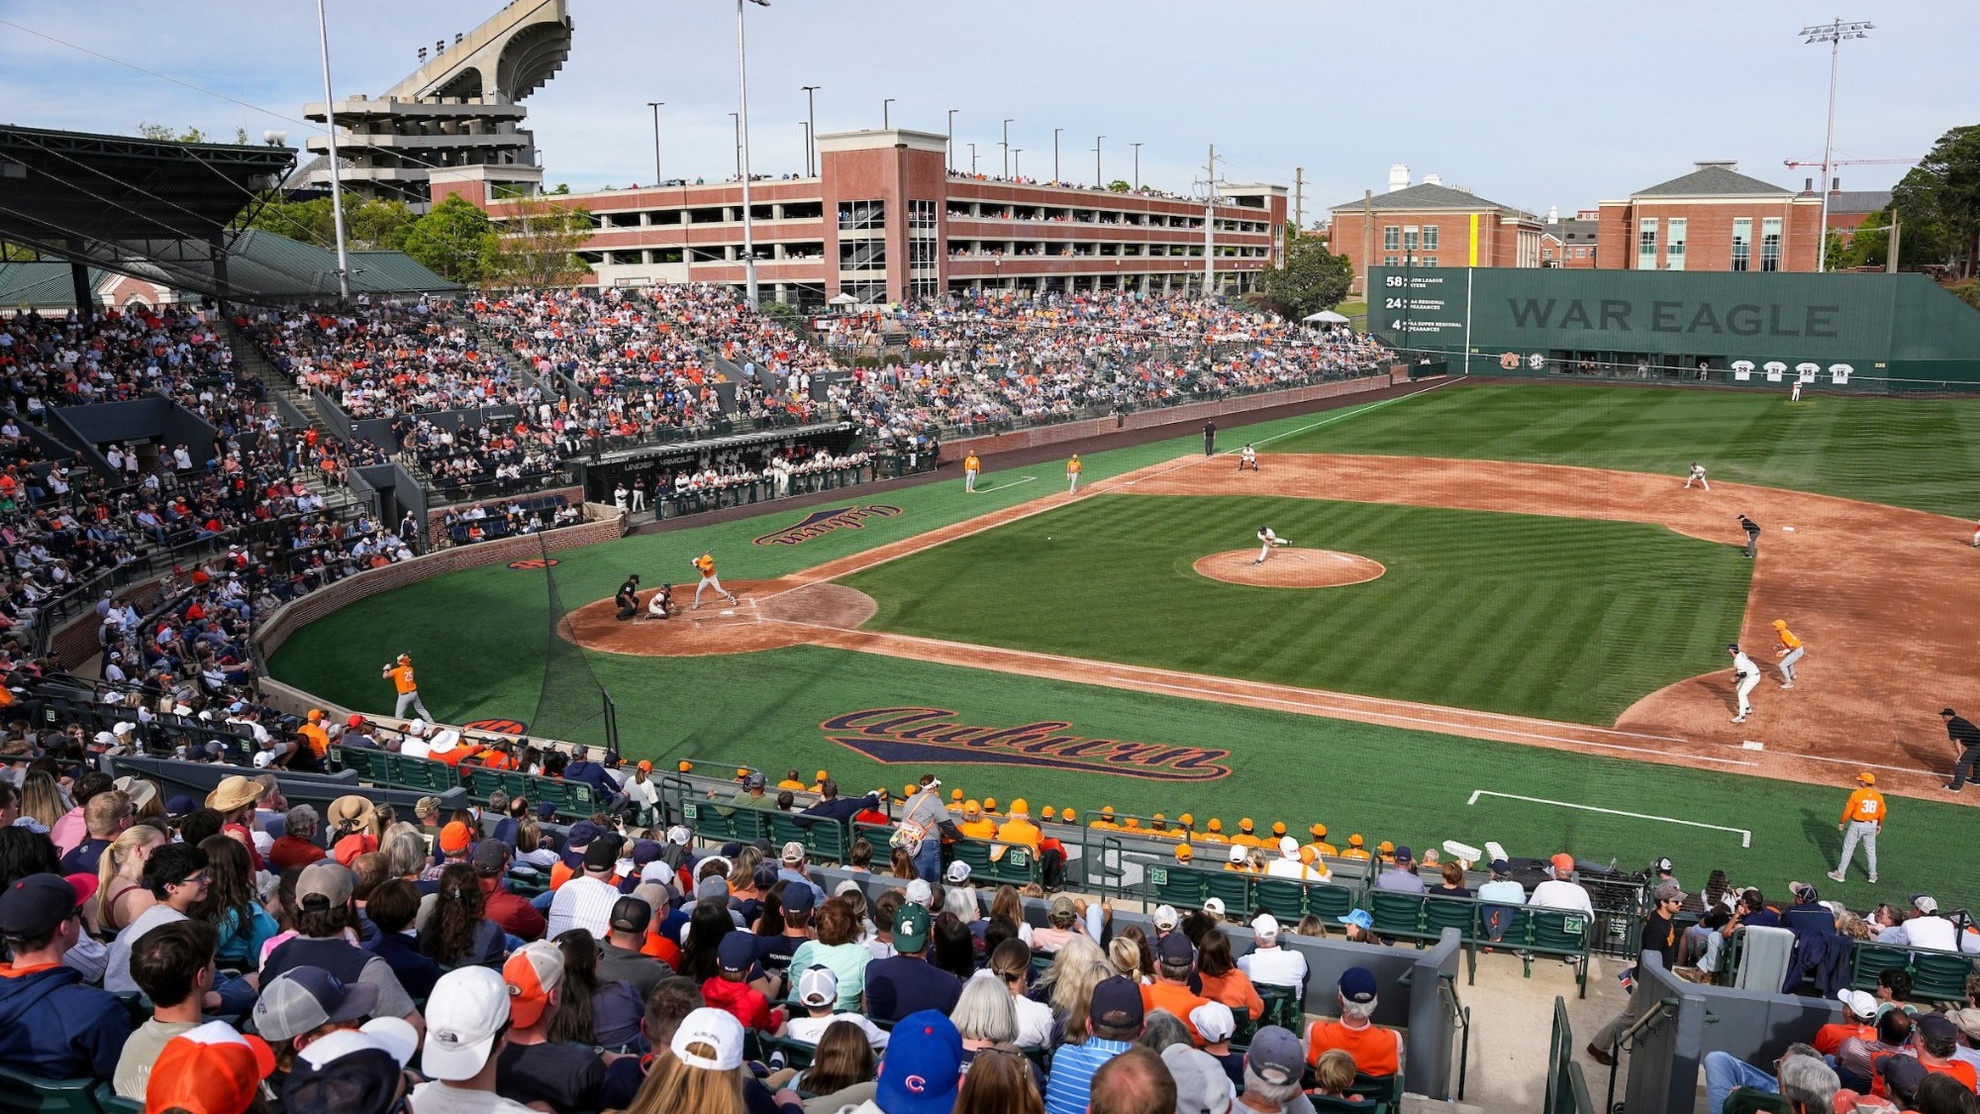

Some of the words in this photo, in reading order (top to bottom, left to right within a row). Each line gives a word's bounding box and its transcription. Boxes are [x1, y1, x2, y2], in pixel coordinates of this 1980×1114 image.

[1386, 276, 1403, 287] 58
[1386, 298, 1402, 309] 24
[1507, 298, 1632, 331] WAR
[1650, 301, 1840, 338] EAGLE
[1392, 320, 1401, 330] 4
[624, 461, 655, 471] UNDER
[819, 707, 1232, 781] Auburn
[1861, 799, 1878, 813] 38
[1012, 853, 1023, 863] 26
[1566, 920, 1580, 931] 24
[905, 1074, 926, 1092] C
